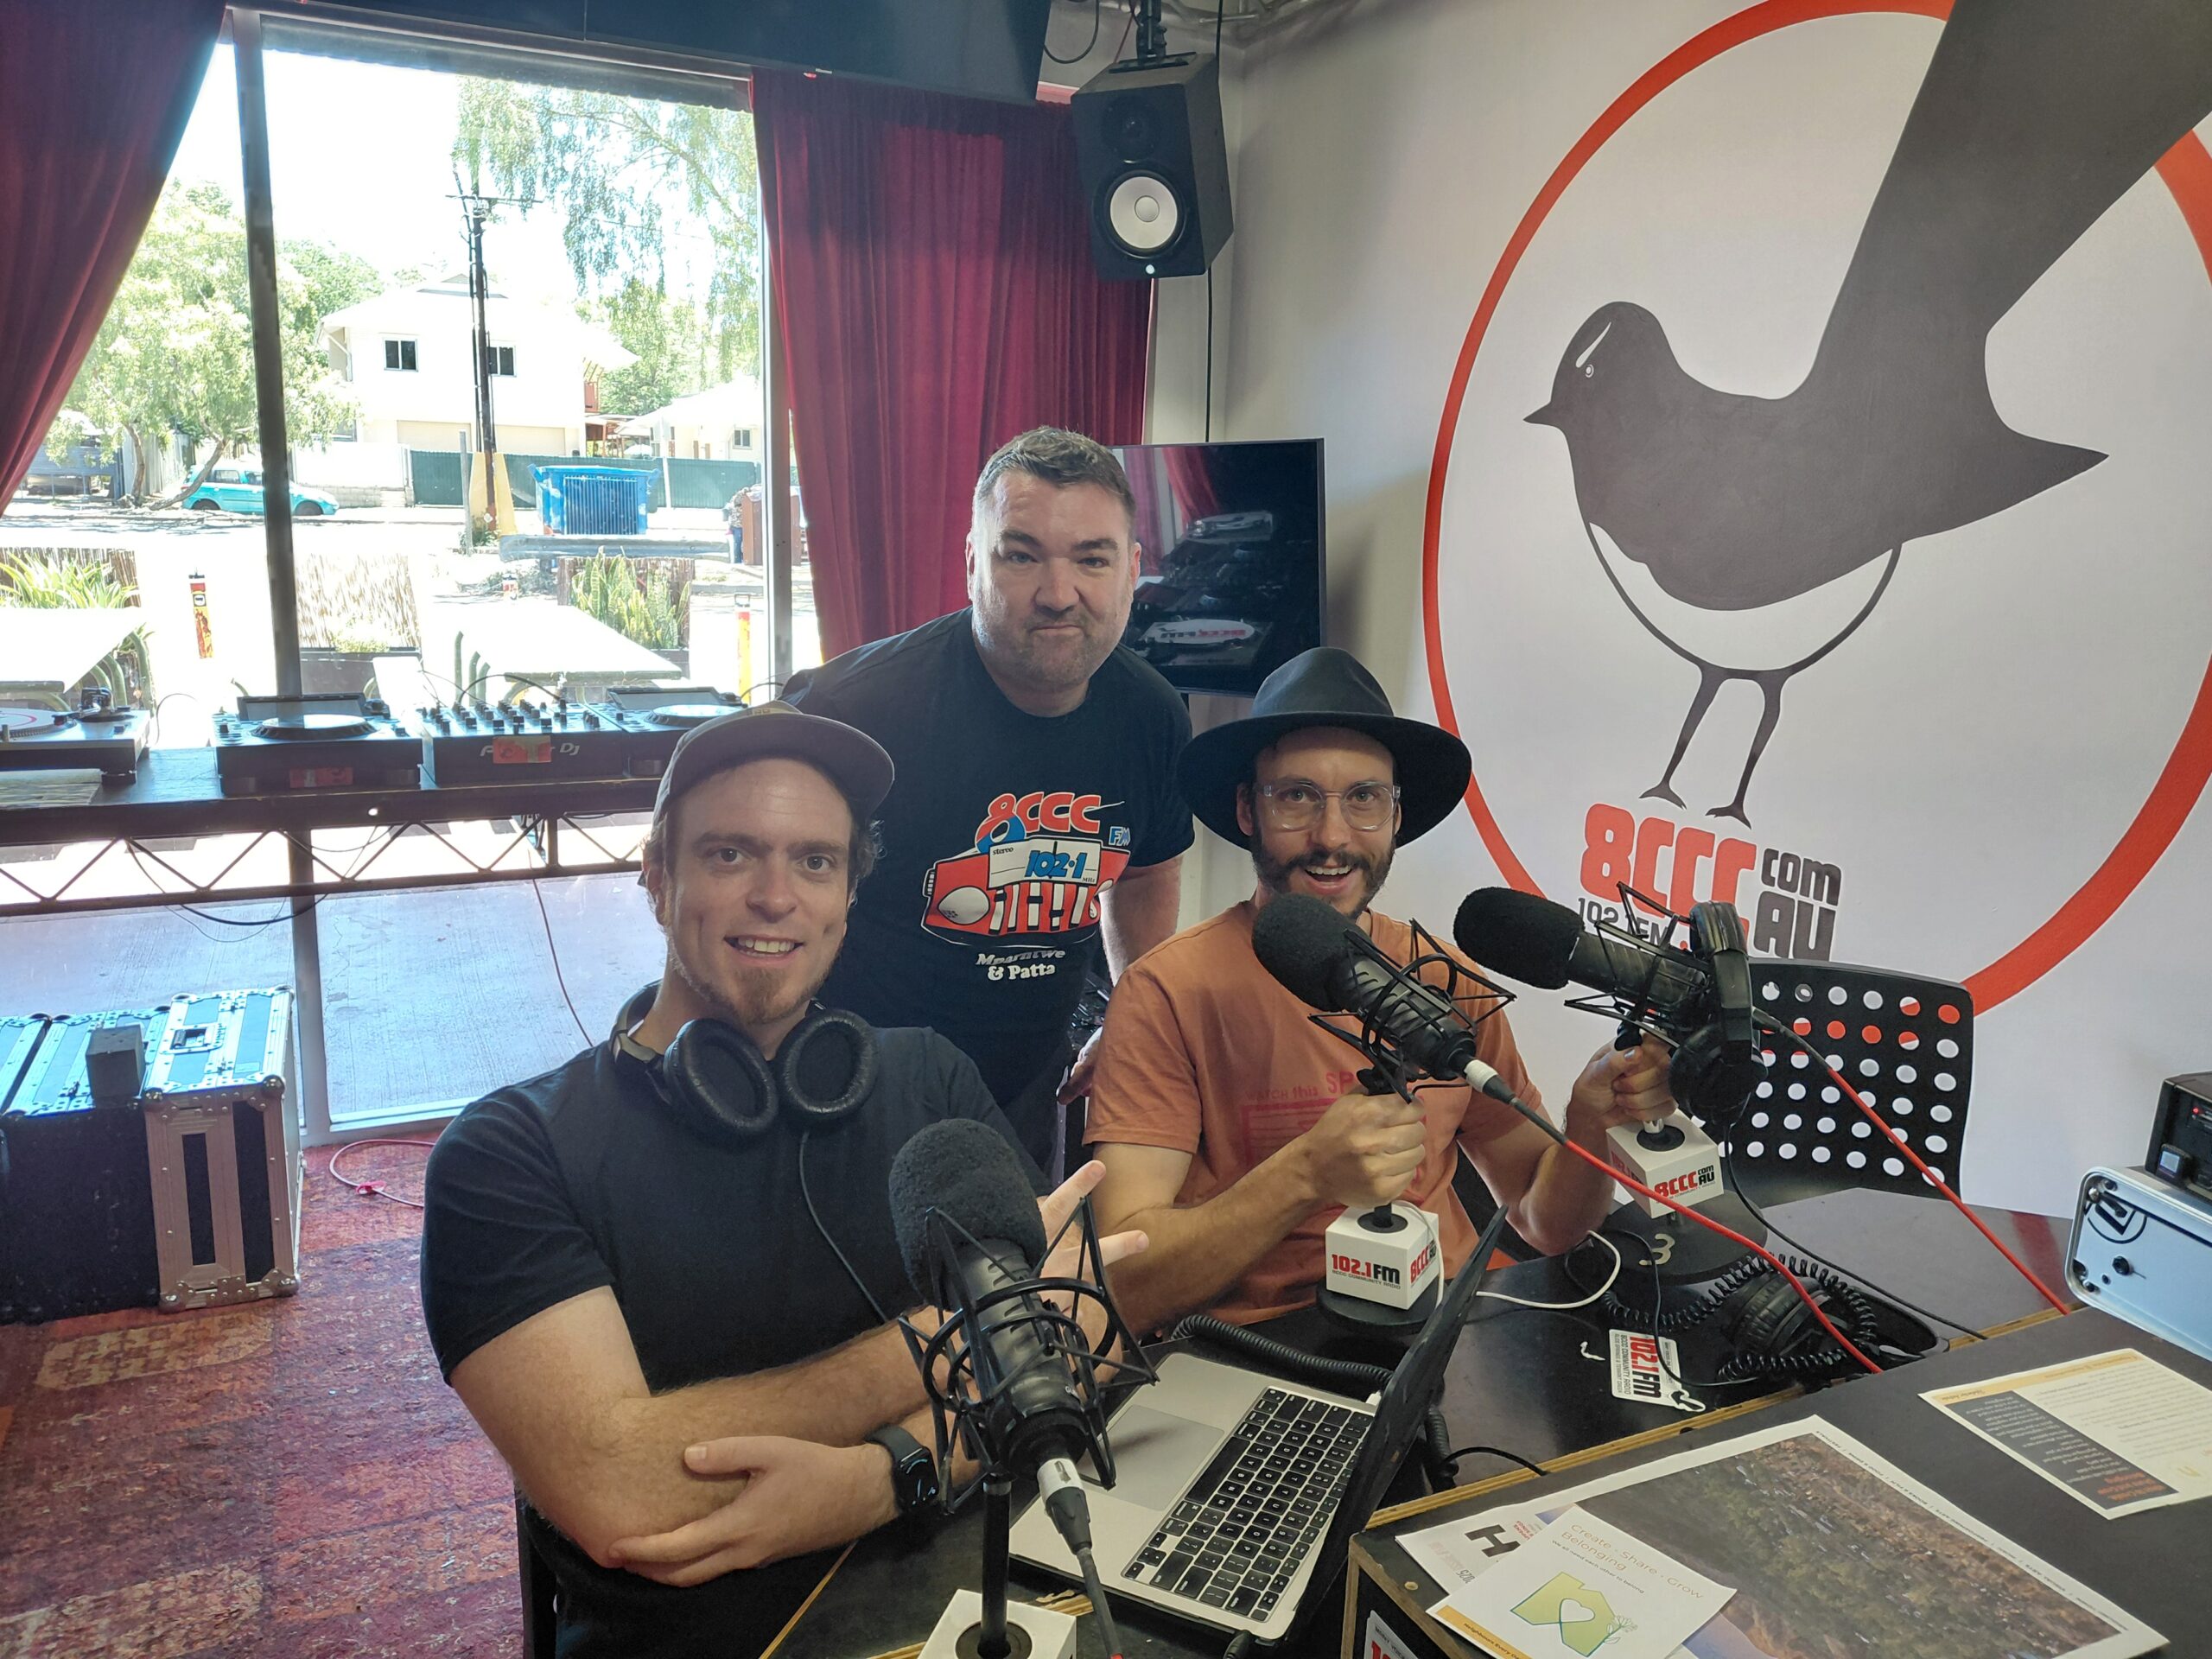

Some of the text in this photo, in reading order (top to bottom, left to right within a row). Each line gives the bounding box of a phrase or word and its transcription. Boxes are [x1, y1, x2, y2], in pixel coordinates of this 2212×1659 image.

[975, 791, 1101, 854] 8CCC
[1109, 826, 1130, 846] FM
[993, 847, 1014, 855] stereo
[1580, 803, 1757, 944] 8CCC
[1754, 891, 1836, 961] AU
[988, 963, 1055, 981] & Patta
[1654, 1170, 1698, 1198] 8CCC
[1698, 1171, 1715, 1185] AU
[1332, 1254, 1401, 1284] 102.1FM
[1621, 1348, 1630, 1378] COMMUNITY
[1630, 1336, 1662, 1398] 102.1FM
[1561, 1531, 1627, 1572] Belonging
[1571, 1524, 1704, 1599] Create Share Grow
[1569, 1550, 1585, 1560] need
[1585, 1558, 1599, 1568] each
[1599, 1567, 1616, 1577] other
[1623, 1580, 1645, 1594] belong
[1494, 1642, 1511, 1656] Every
